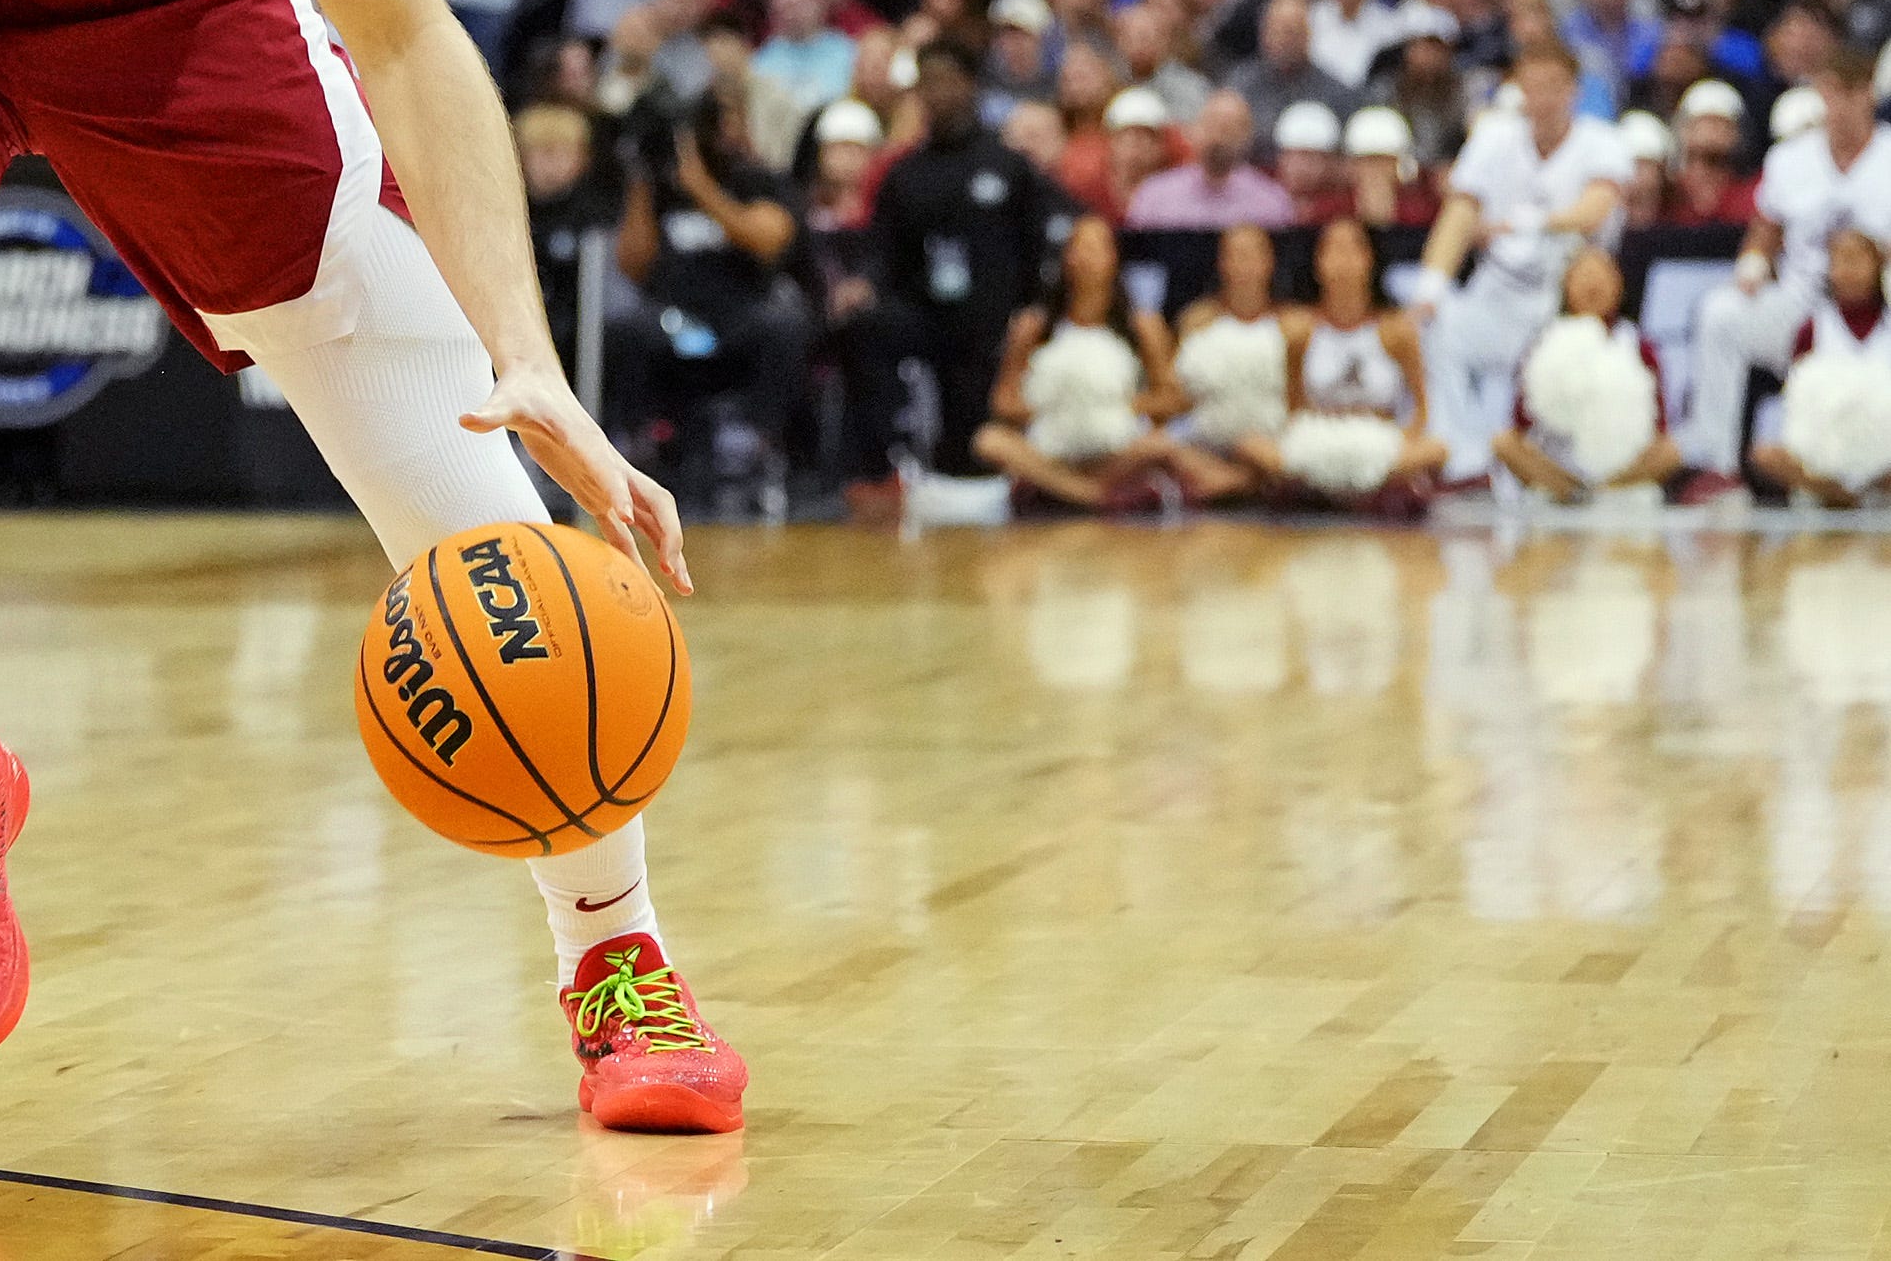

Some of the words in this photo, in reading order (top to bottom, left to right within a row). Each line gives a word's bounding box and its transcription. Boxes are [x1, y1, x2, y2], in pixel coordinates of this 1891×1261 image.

[424, 632, 442, 660] EVO
[461, 537, 549, 665] NCAA
[383, 564, 473, 768] Wilson
